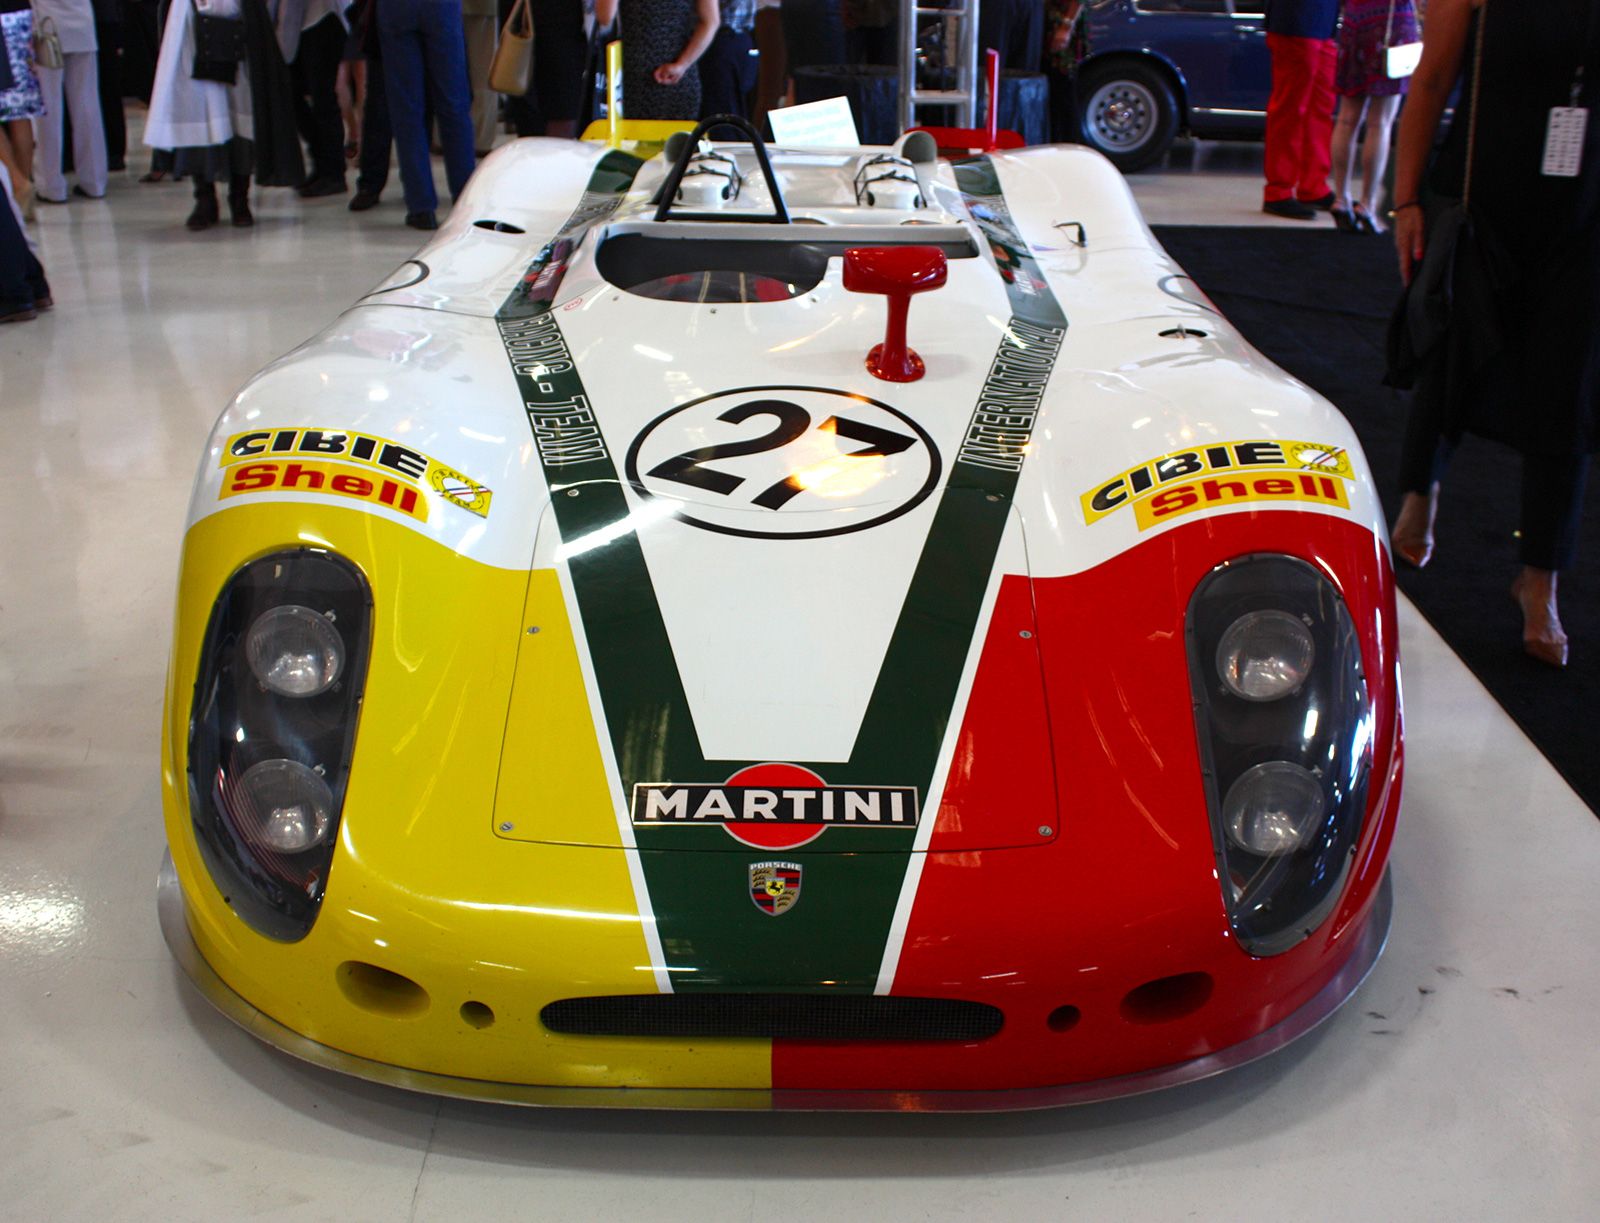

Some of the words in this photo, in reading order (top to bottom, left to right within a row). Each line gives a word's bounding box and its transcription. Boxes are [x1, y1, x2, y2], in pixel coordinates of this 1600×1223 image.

[498, 311, 573, 375] RACING
[957, 319, 1065, 473] INTERNATIONAL
[231, 430, 428, 480] CIBIE
[527, 394, 608, 467] TEAM
[231, 464, 418, 514] Shell
[1092, 442, 1286, 511] CIBIE
[1151, 475, 1338, 517] Shell
[645, 789, 904, 822] MARTINI
[750, 862, 801, 870] PORSCHE
